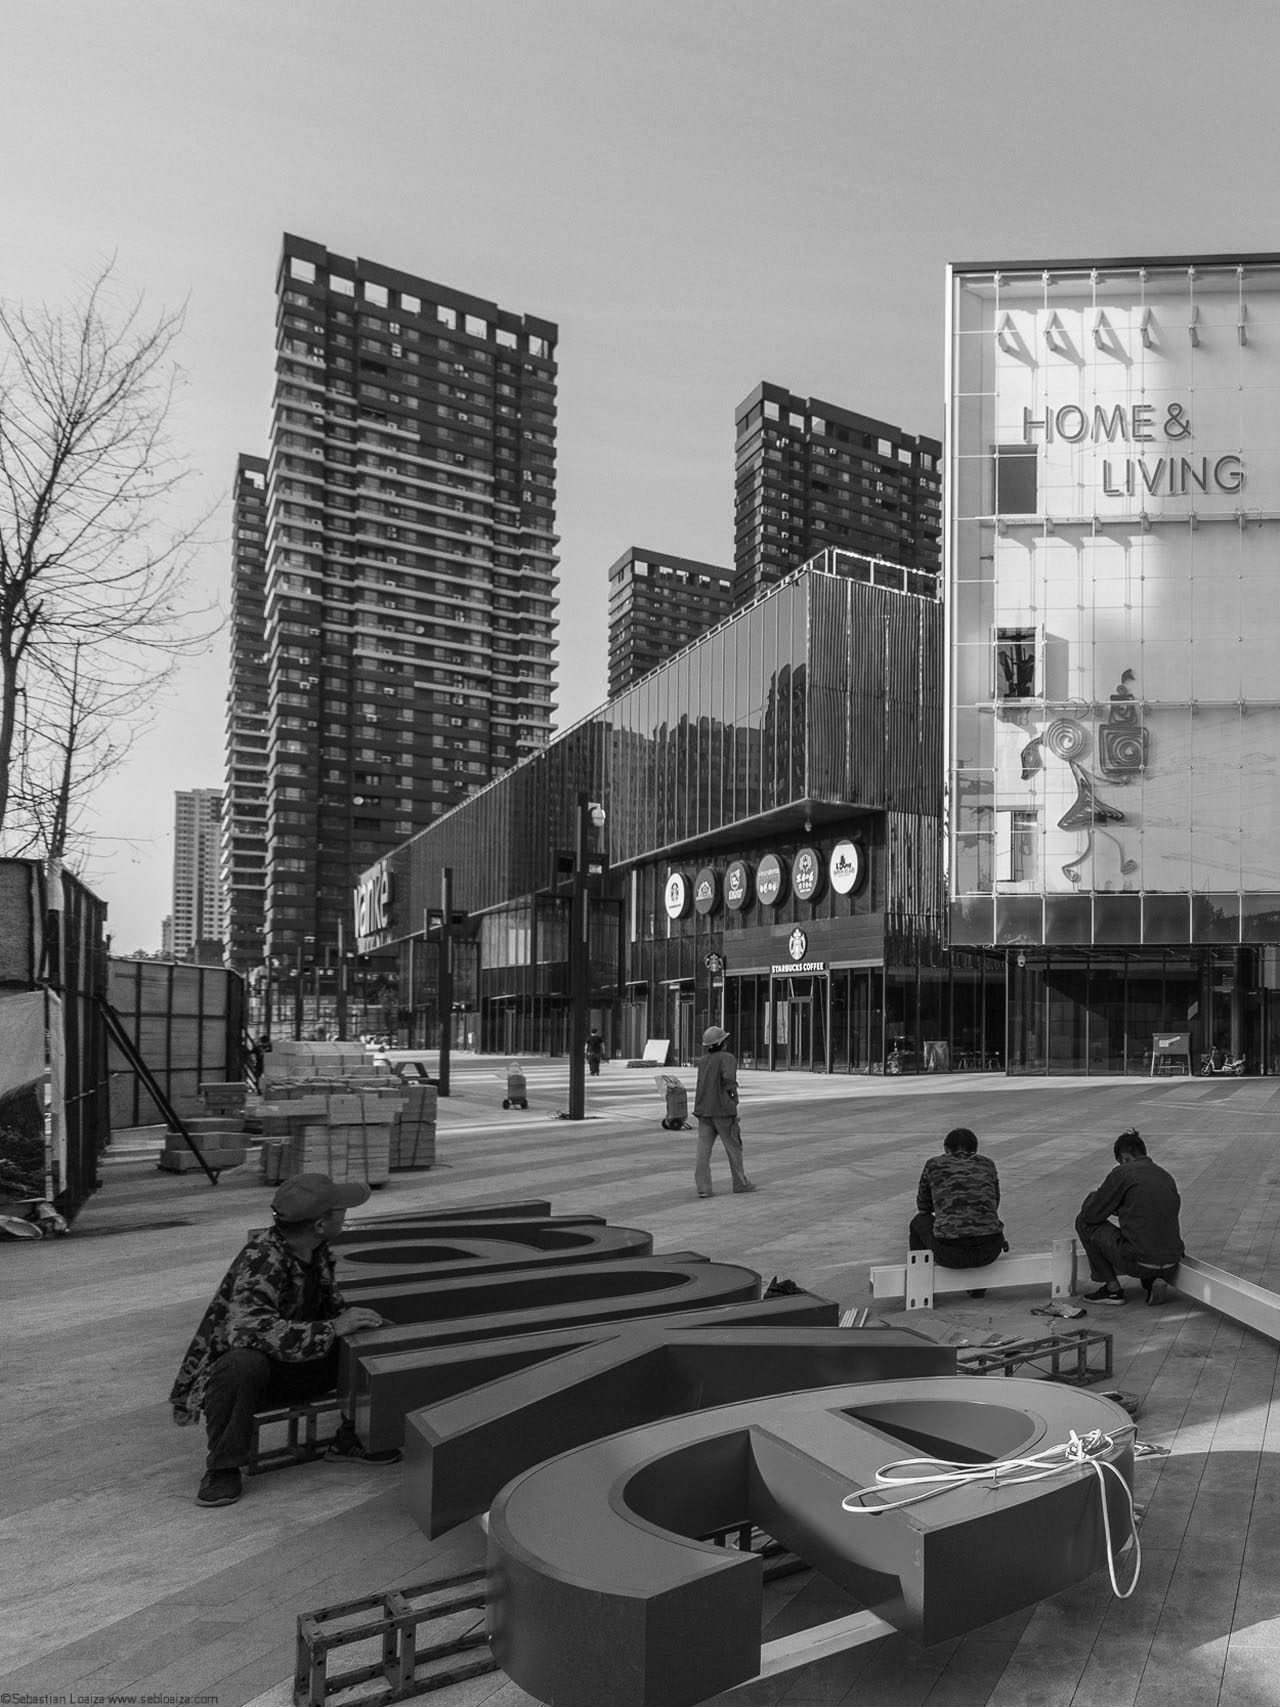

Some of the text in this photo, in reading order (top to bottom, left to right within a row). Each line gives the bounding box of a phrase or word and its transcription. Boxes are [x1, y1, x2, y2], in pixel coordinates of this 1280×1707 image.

[1023, 402, 1193, 442] HOME &
[1103, 454, 1245, 495] LIVING
[771, 961, 824, 974] STARBUCKS COFFEE
